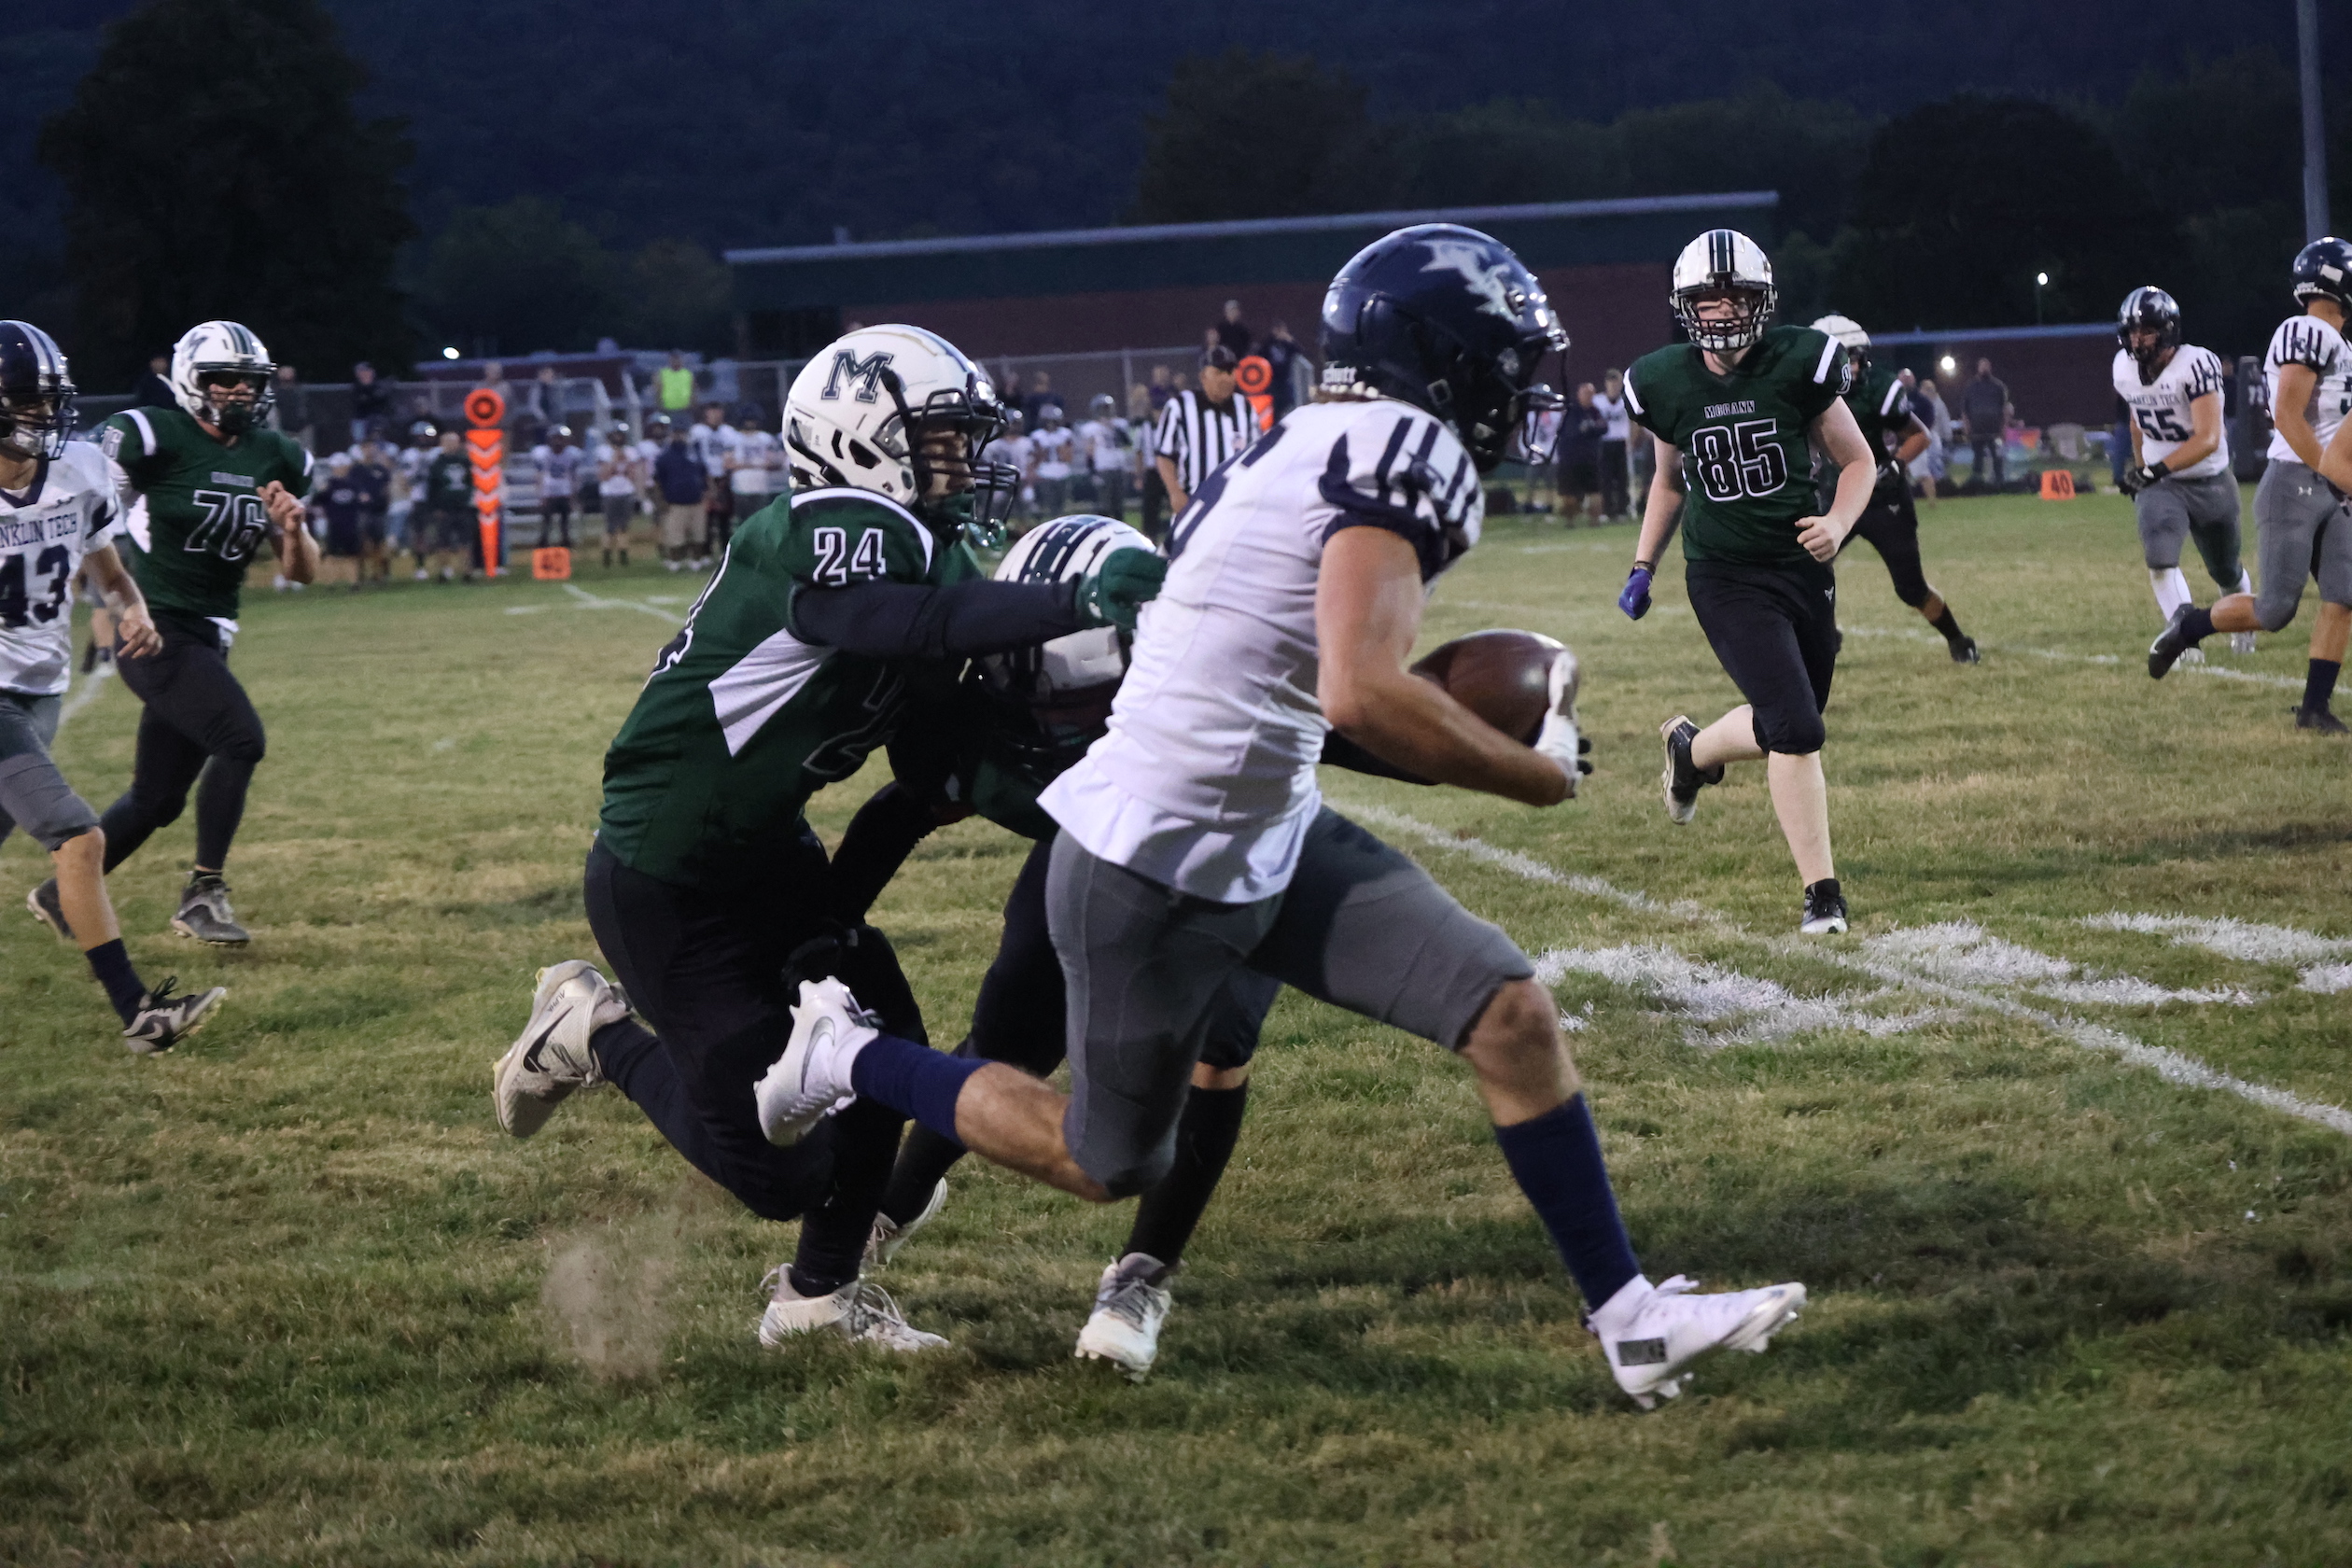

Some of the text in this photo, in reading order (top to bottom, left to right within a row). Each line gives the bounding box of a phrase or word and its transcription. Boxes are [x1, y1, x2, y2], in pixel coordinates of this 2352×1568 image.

[821, 349, 894, 403] M
[2136, 408, 2190, 441] 55
[1691, 417, 1788, 502] 85
[48, 512, 77, 539] TECH
[183, 489, 268, 561] 76
[0, 543, 70, 628] 43
[813, 526, 887, 586] 24
